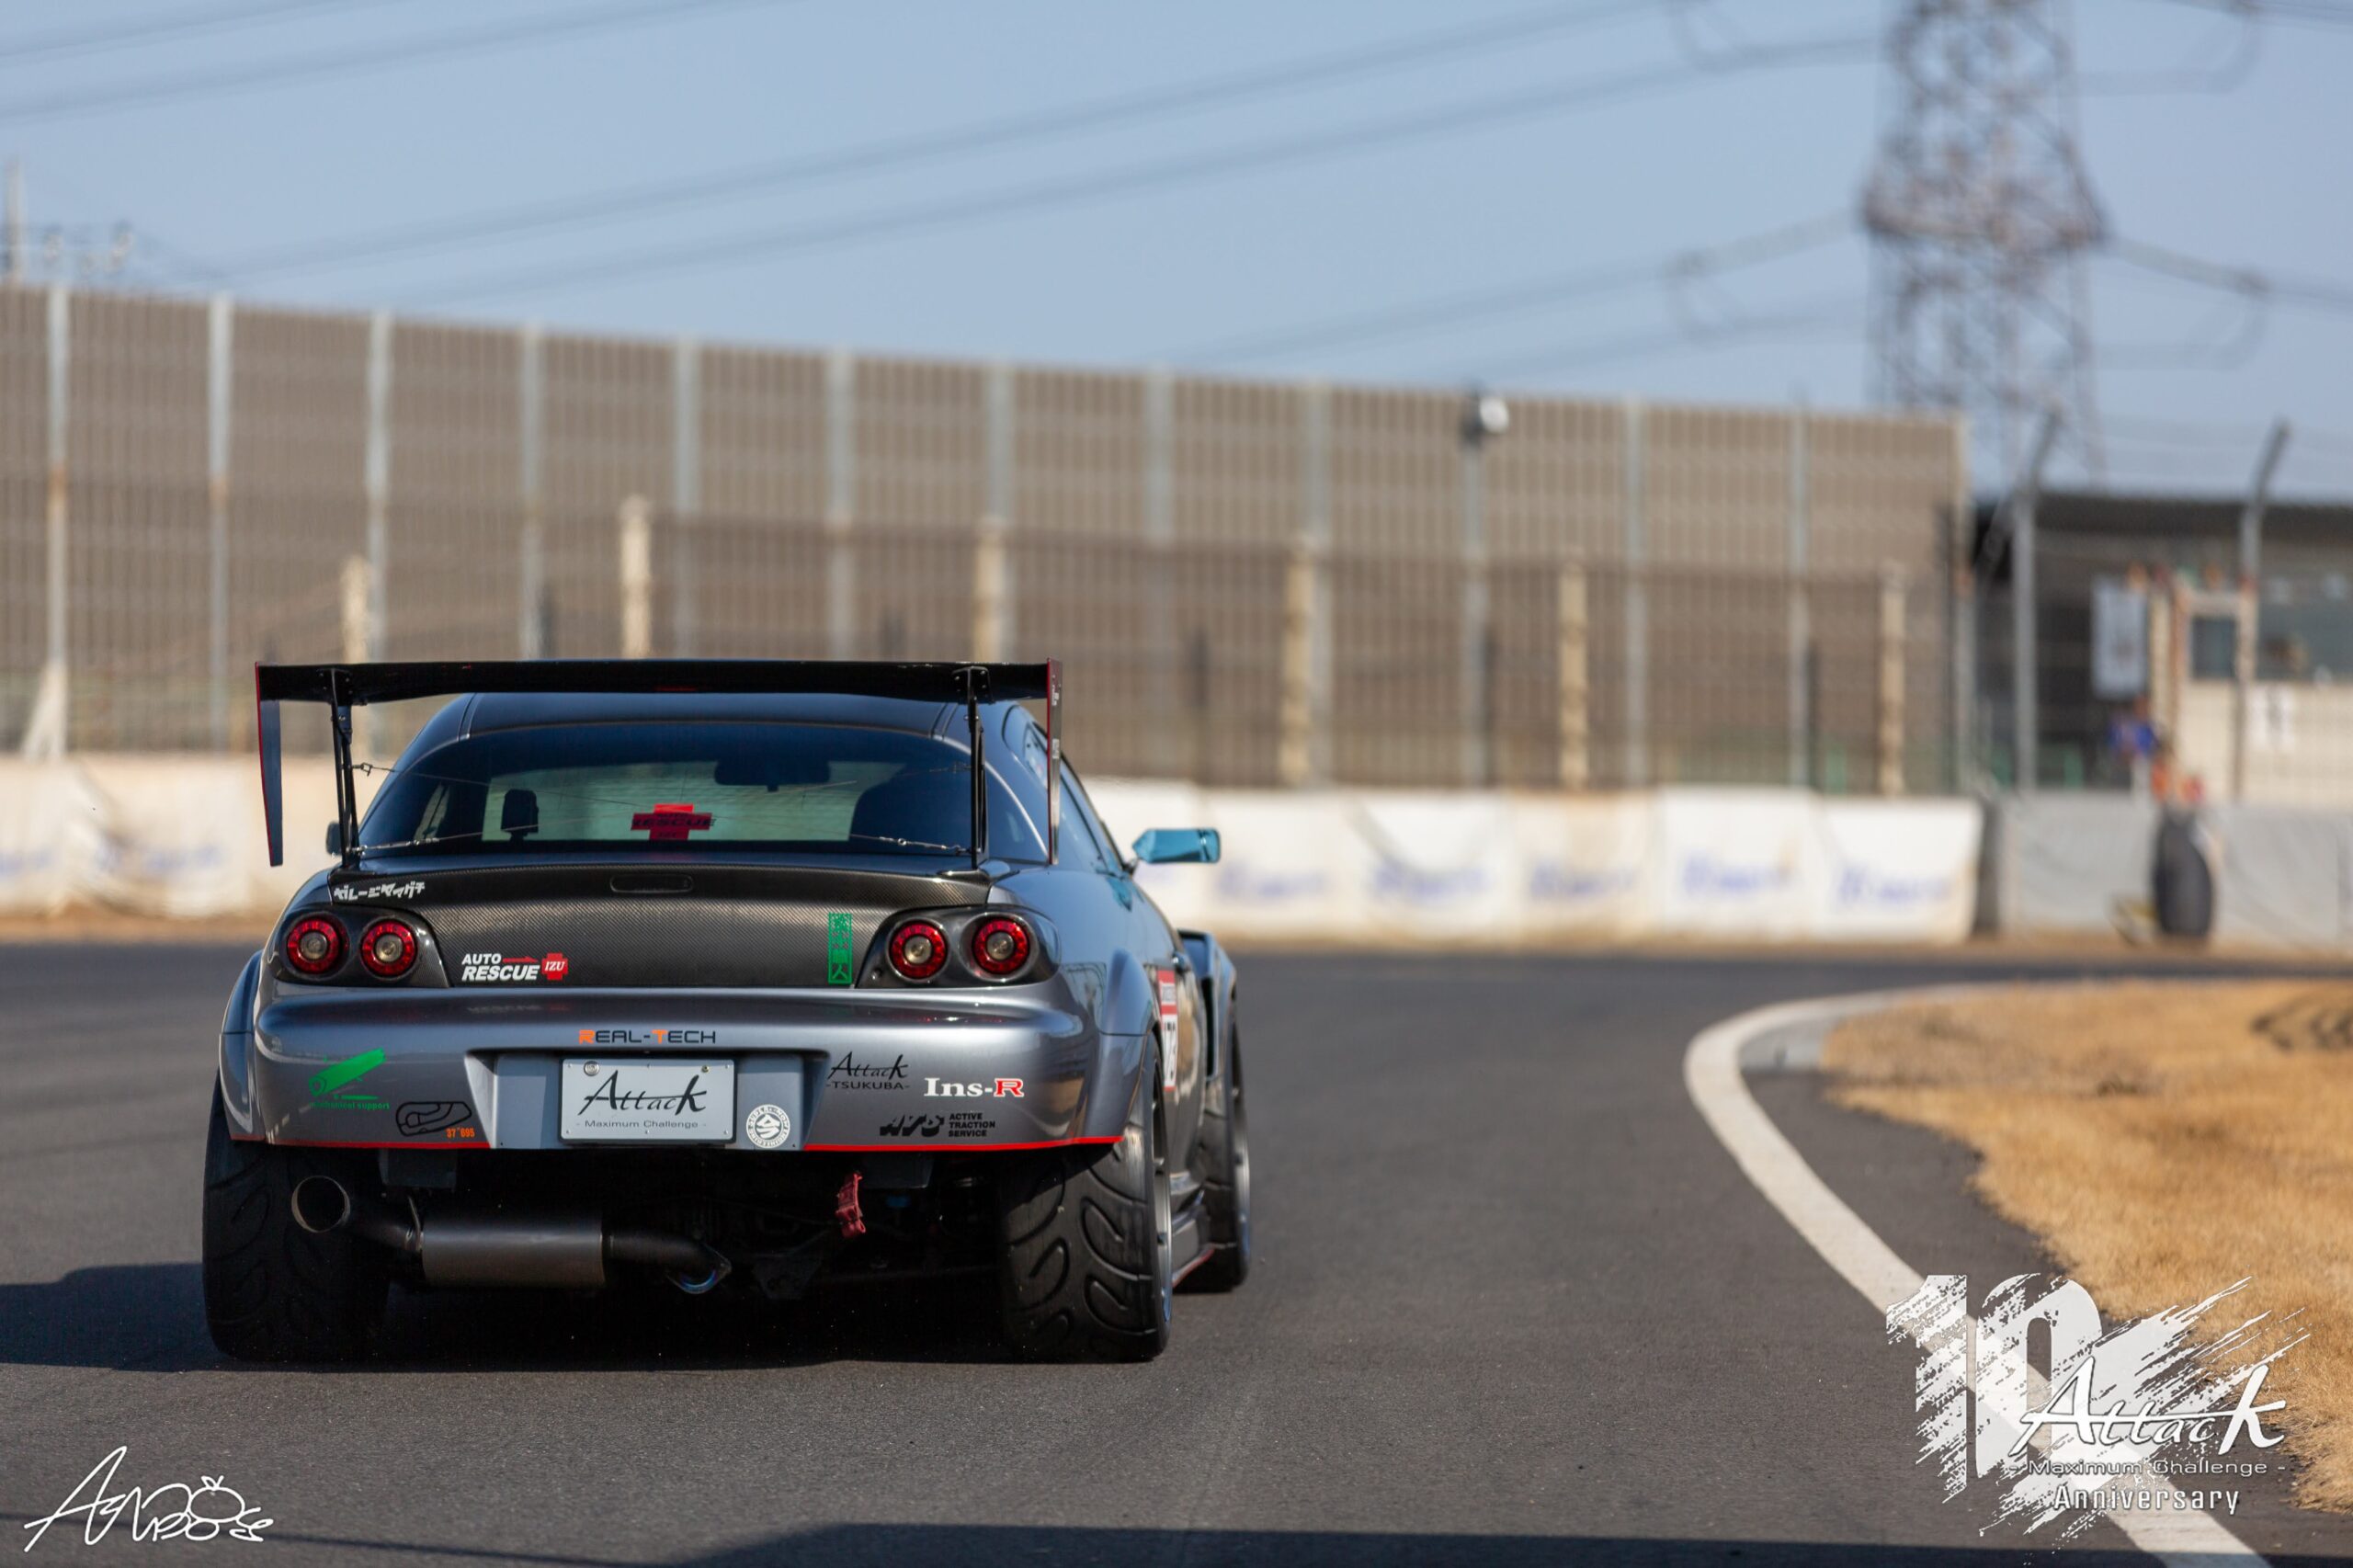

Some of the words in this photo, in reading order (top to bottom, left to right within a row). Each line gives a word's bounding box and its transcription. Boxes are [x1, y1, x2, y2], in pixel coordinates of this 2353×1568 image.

[460, 953, 503, 965] AUTO
[544, 961, 565, 971] IZU
[460, 965, 540, 982] RESCUE
[578, 1029, 716, 1044] REAL-TECH
[827, 1051, 909, 1080] Attack
[576, 1069, 708, 1116] Attack
[924, 1077, 1025, 1097] Ins-R
[357, 1102, 390, 1111] support
[949, 1112, 983, 1120] ACTIVE
[585, 1119, 640, 1128] Maximum
[643, 1119, 699, 1130] Challenge
[949, 1120, 996, 1129] TRACTION
